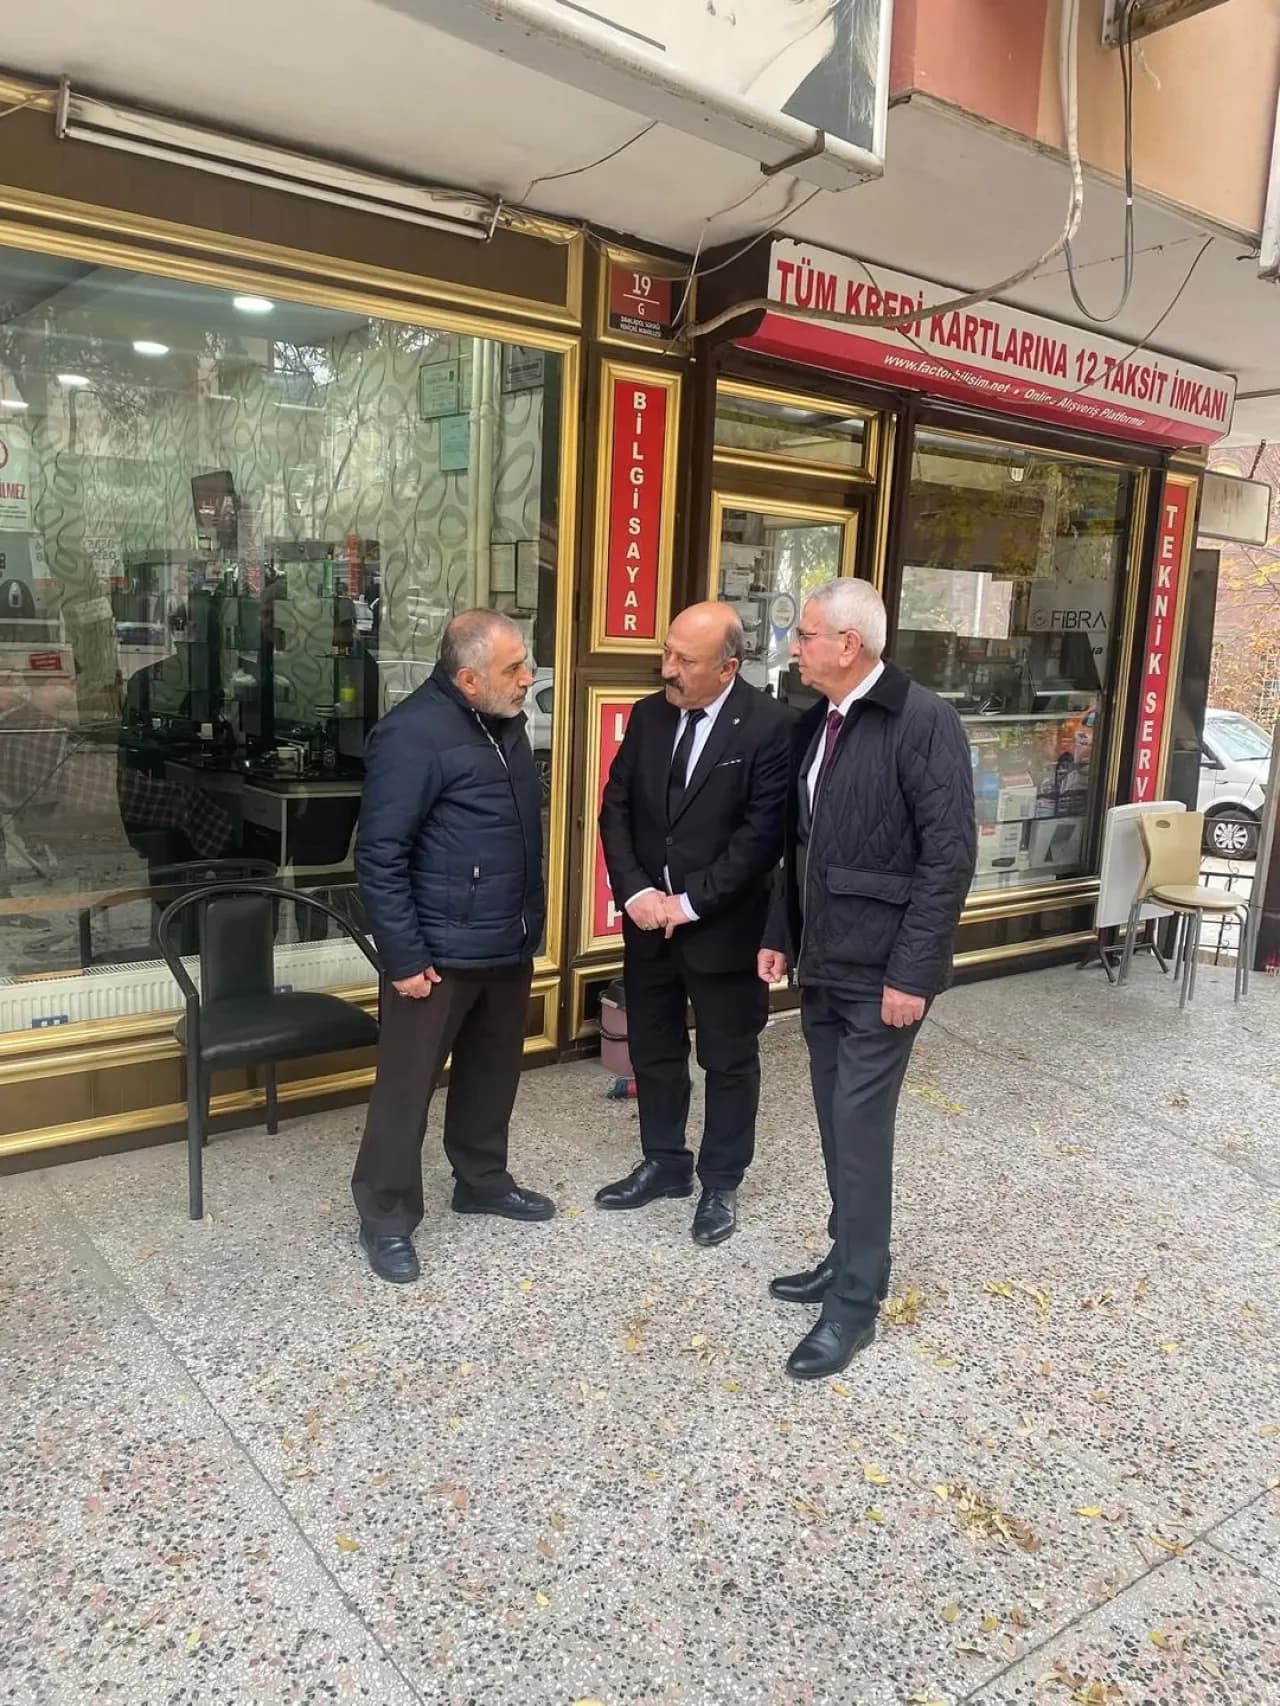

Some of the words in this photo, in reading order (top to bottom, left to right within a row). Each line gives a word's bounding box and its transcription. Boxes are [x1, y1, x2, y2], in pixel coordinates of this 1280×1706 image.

[632, 273, 652, 296] 19
[638, 303, 645, 316] G
[776, 257, 838, 313] TÜM
[845, 279, 924, 338] KREDİ
[929, 310, 1068, 379] KARTLARINA
[1076, 348, 1098, 387] 12
[1103, 356, 1169, 404] TAKSİT
[1169, 369, 1229, 422] İMKANI
[623, 391, 648, 632] BİLGİSAYAR
[1148, 505, 1178, 676] TEKNİK
[1136, 691, 1157, 801] SERV
